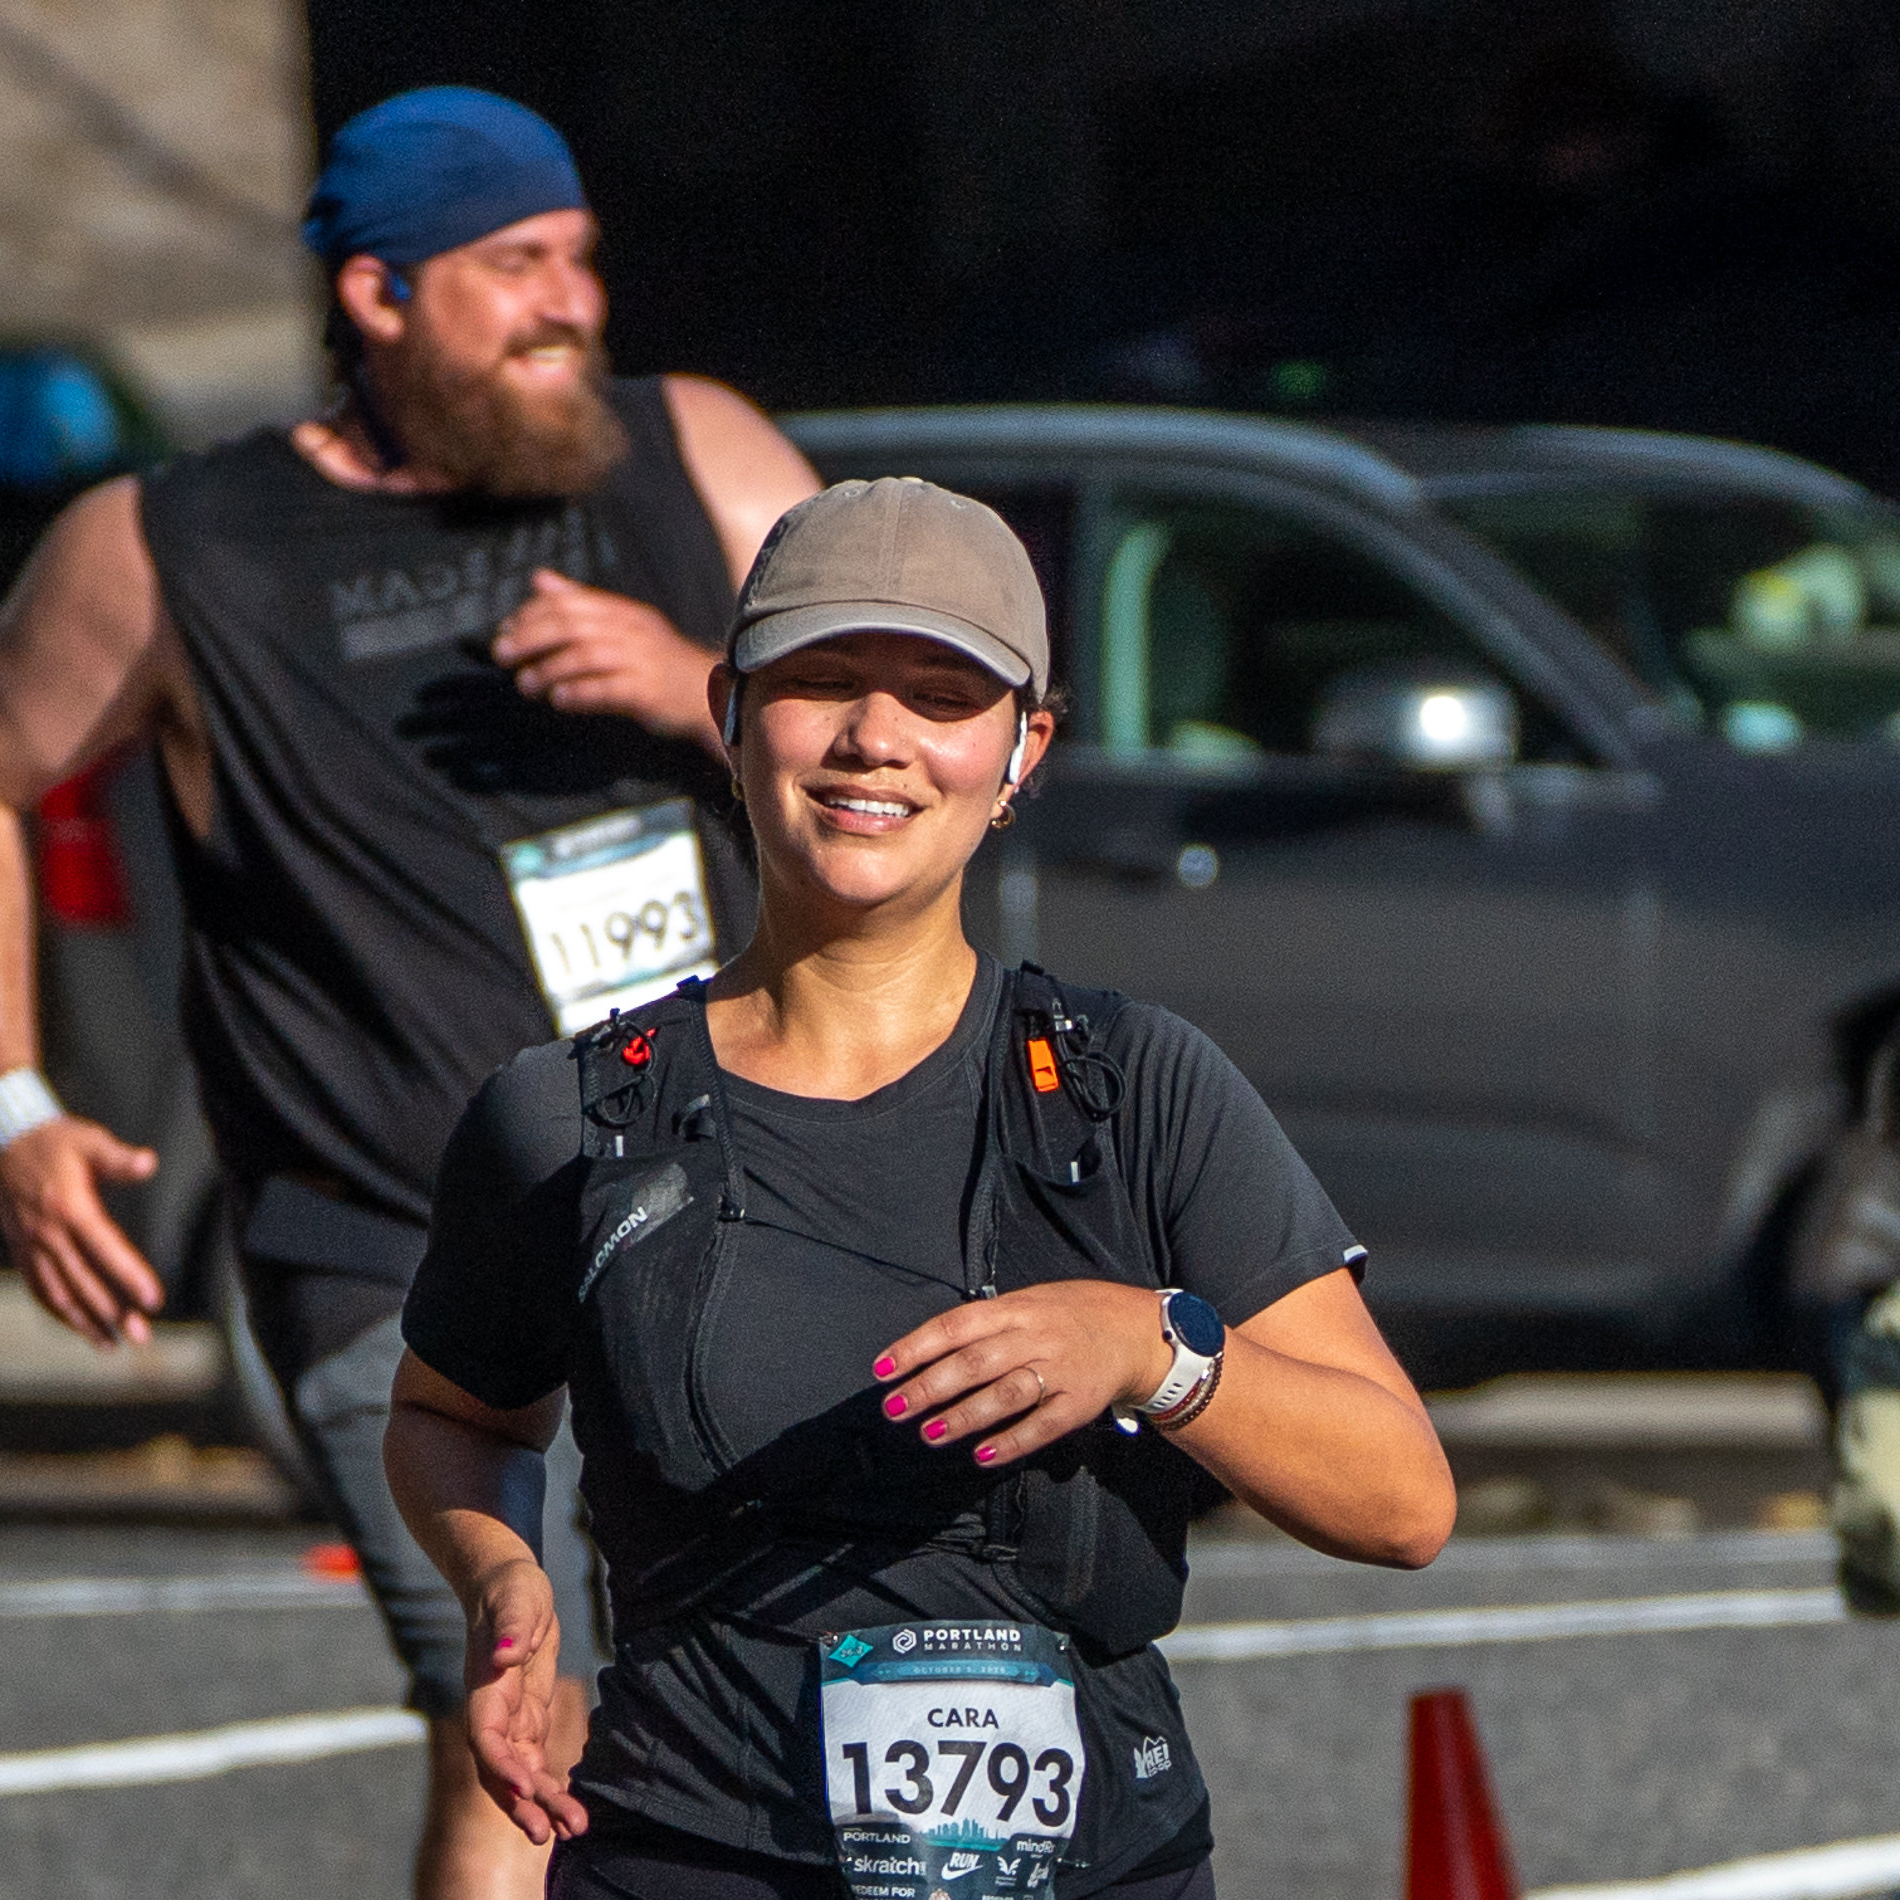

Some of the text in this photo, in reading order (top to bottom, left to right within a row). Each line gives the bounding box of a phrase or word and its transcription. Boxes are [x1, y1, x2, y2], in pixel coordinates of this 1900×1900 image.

[548, 891, 700, 977] 11993
[923, 1629, 1021, 1642] PORTLAND
[924, 1642, 1021, 1652] MARATHON
[927, 1708, 999, 1729] CARA
[842, 1739, 1074, 1827] 13793
[843, 1831, 911, 1844] PORTLAND
[853, 1855, 920, 1876] skratch
[950, 1852, 980, 1868] RUN
[891, 1886, 916, 1898] FOR
